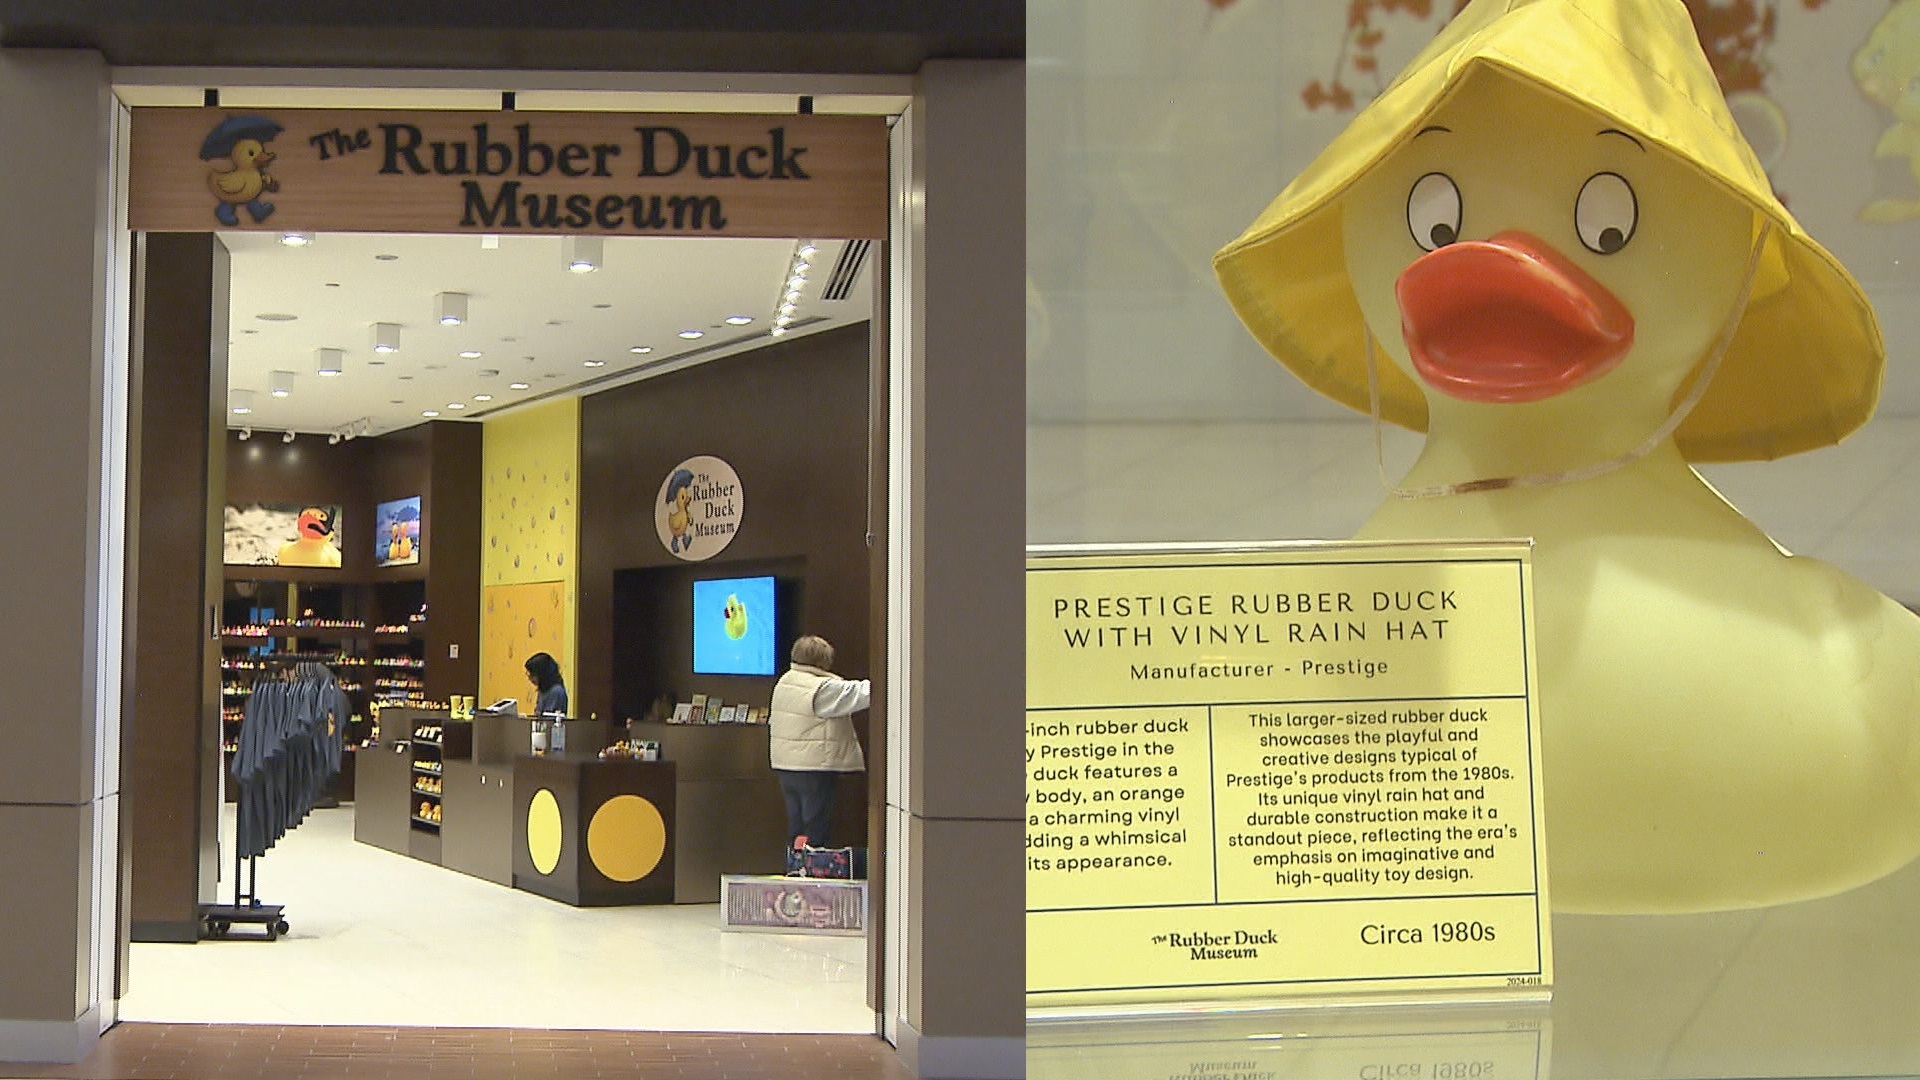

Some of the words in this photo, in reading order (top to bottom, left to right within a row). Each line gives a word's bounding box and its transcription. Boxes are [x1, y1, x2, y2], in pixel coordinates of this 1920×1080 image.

[309, 128, 371, 160] The
[377, 122, 621, 177] Rubber
[634, 126, 811, 180] Duck
[459, 180, 727, 230] Museum
[698, 473, 710, 483] The
[693, 481, 735, 501] Rubber
[705, 498, 735, 519] Duck
[695, 522, 735, 537] Museum
[1054, 595, 1213, 619] PRESTIGE
[1231, 592, 1354, 615] RUBBER
[1373, 590, 1457, 612] DUCK
[1064, 626, 1152, 648] WITH
[1171, 623, 1270, 645] VINYL
[1288, 621, 1366, 643] RAIN
[1386, 619, 1449, 641] HAT
[1130, 663, 1274, 680] Manufacturer
[1302, 658, 1388, 679] Prestige
[1075, 719, 1139, 736] rubber
[1143, 717, 1189, 734] duck
[1248, 713, 1282, 728] This
[1286, 709, 1387, 730] larger-sized
[1392, 708, 1445, 724] rubber
[1449, 707, 1488, 723] duck
[1260, 732, 1350, 747] showcases
[1354, 730, 1381, 745] the
[1385, 727, 1443, 747] playful
[1447, 727, 1478, 742] and
[1041, 742, 1117, 761] Prestige
[1122, 741, 1139, 757] in
[1143, 741, 1175, 756] the
[1262, 751, 1330, 767] creative
[1333, 749, 1397, 767] designs
[1401, 747, 1457, 766] typical
[1461, 746, 1478, 761] of
[1033, 765, 1079, 782] duck
[1083, 764, 1163, 780] features
[1167, 765, 1178, 777] a
[1226, 770, 1307, 790] Prestige's
[1311, 769, 1385, 788] products
[1388, 768, 1427, 783] from
[1431, 767, 1458, 782] the
[1462, 765, 1514, 781] 1980s.
[1035, 787, 1087, 806] body,
[1092, 790, 1115, 802] an
[1119, 787, 1185, 803] orange
[1258, 792, 1278, 807] Its
[1282, 790, 1338, 808] unique
[1342, 788, 1382, 807] vinyl
[1386, 787, 1418, 803] rain
[1422, 786, 1449, 802] hat
[1453, 785, 1485, 801] and
[1028, 814, 1039, 827] a
[1044, 808, 1133, 827] charming
[1137, 806, 1180, 825] vinyl
[1246, 810, 1310, 827] durable
[1314, 807, 1419, 824] construction
[1423, 805, 1468, 821] make
[1472, 805, 1483, 820] it
[1487, 808, 1498, 819] a
[1079, 835, 1090, 847] a
[1094, 828, 1187, 846] whimsical
[1228, 831, 1303, 847] standout
[1307, 829, 1357, 848] piece,
[1361, 826, 1442, 844] reflecting
[1446, 825, 1473, 841] the
[1477, 823, 1518, 840] era's
[1027, 856, 1051, 871] its
[1056, 855, 1172, 873] appearance.
[1253, 849, 1333, 869] emphasis
[1336, 851, 1357, 864] on
[1361, 845, 1459, 865] imaginative
[1463, 844, 1495, 860] and
[1276, 867, 1380, 888] high-quality
[1384, 868, 1411, 885] toy
[1414, 865, 1474, 883] design.
[1169, 932, 1231, 948] Rubber
[1234, 929, 1278, 945] Duck
[1360, 924, 1423, 945] Circa
[1432, 921, 1496, 943] 1980s
[1190, 947, 1258, 960] Museum
